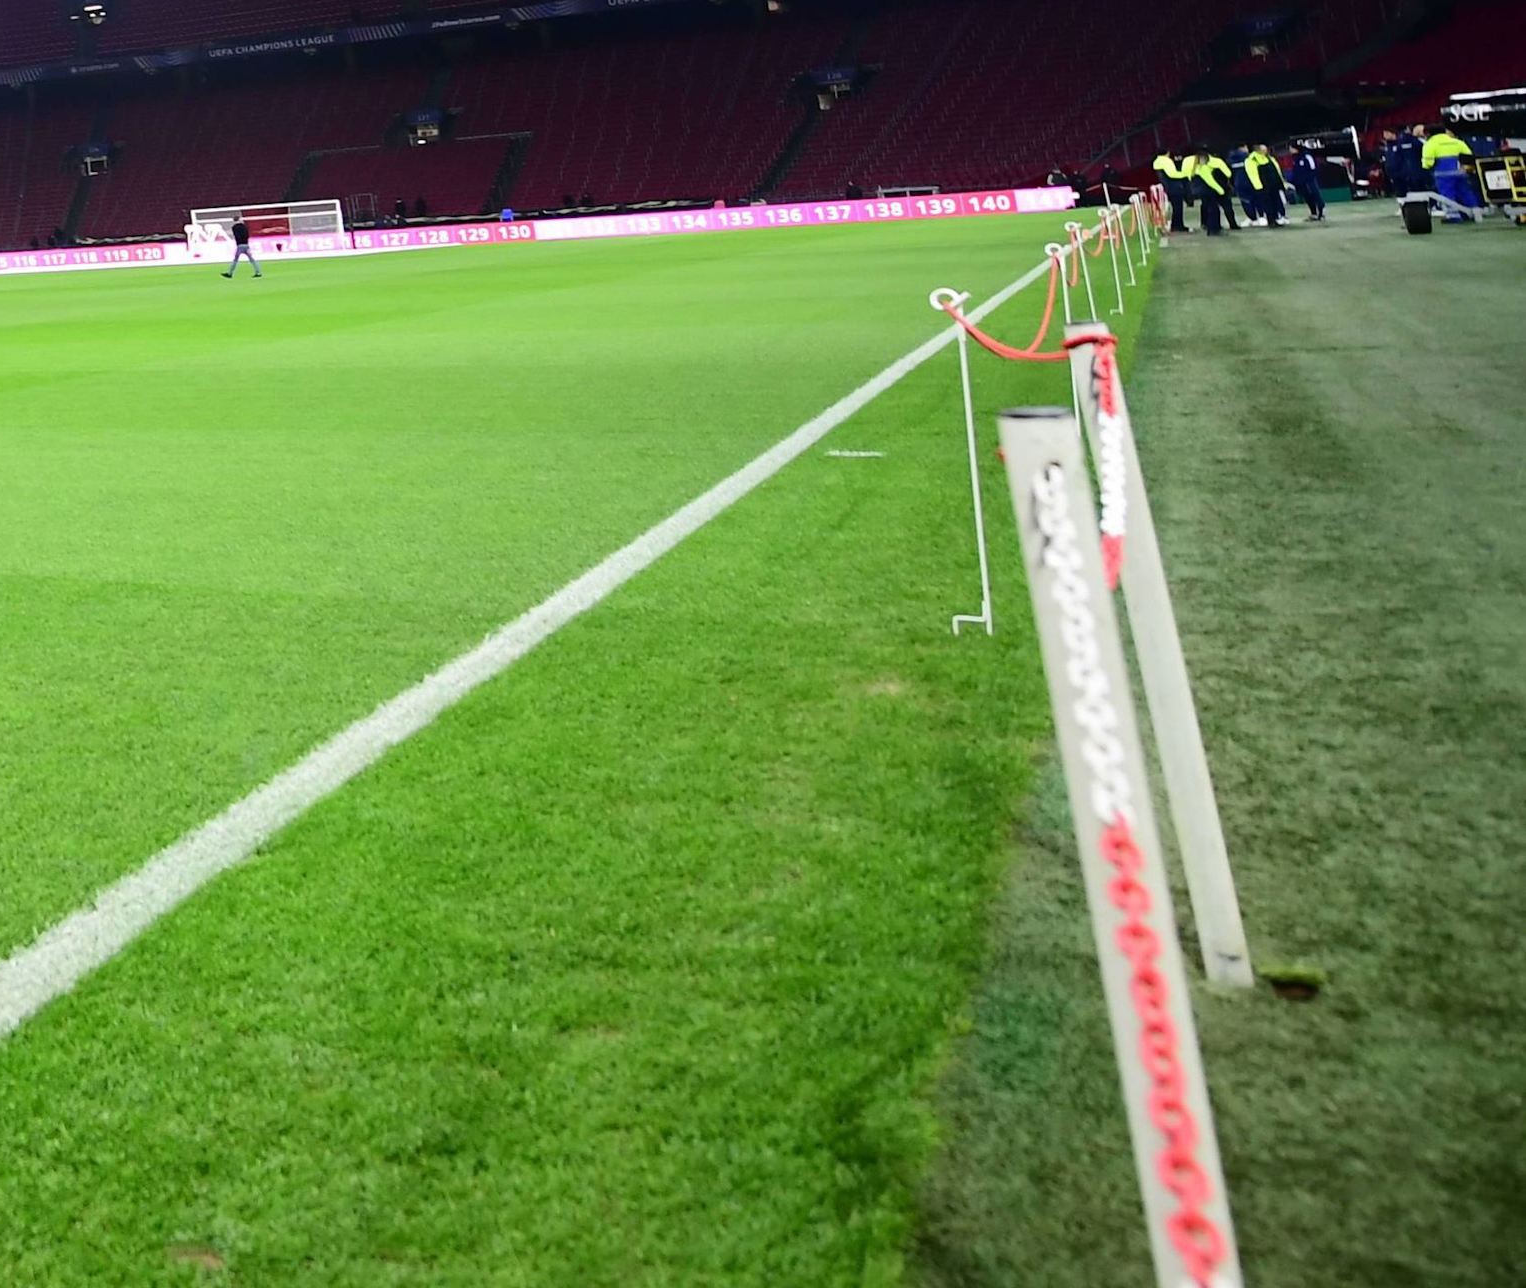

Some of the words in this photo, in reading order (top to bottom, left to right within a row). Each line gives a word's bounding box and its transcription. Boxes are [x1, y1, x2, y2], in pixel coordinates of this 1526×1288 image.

[208, 47, 234, 57] UEFA
[235, 40, 294, 54] CHAMPIONS
[295, 34, 335, 46] LEAGUE
[43, 253, 66, 265] 117
[74, 252, 97, 264] 118
[105, 250, 128, 261] 119
[136, 248, 160, 261] 120
[382, 233, 408, 246] 127
[419, 231, 449, 243] 128
[459, 228, 489, 241] 129
[499, 225, 530, 239] 130
[672, 214, 705, 228] 134
[720, 211, 753, 225] 135
[766, 208, 802, 222] 136
[816, 205, 850, 220] 137
[866, 201, 903, 216] 138
[918, 198, 955, 214] 139
[969, 195, 1010, 211] 140
